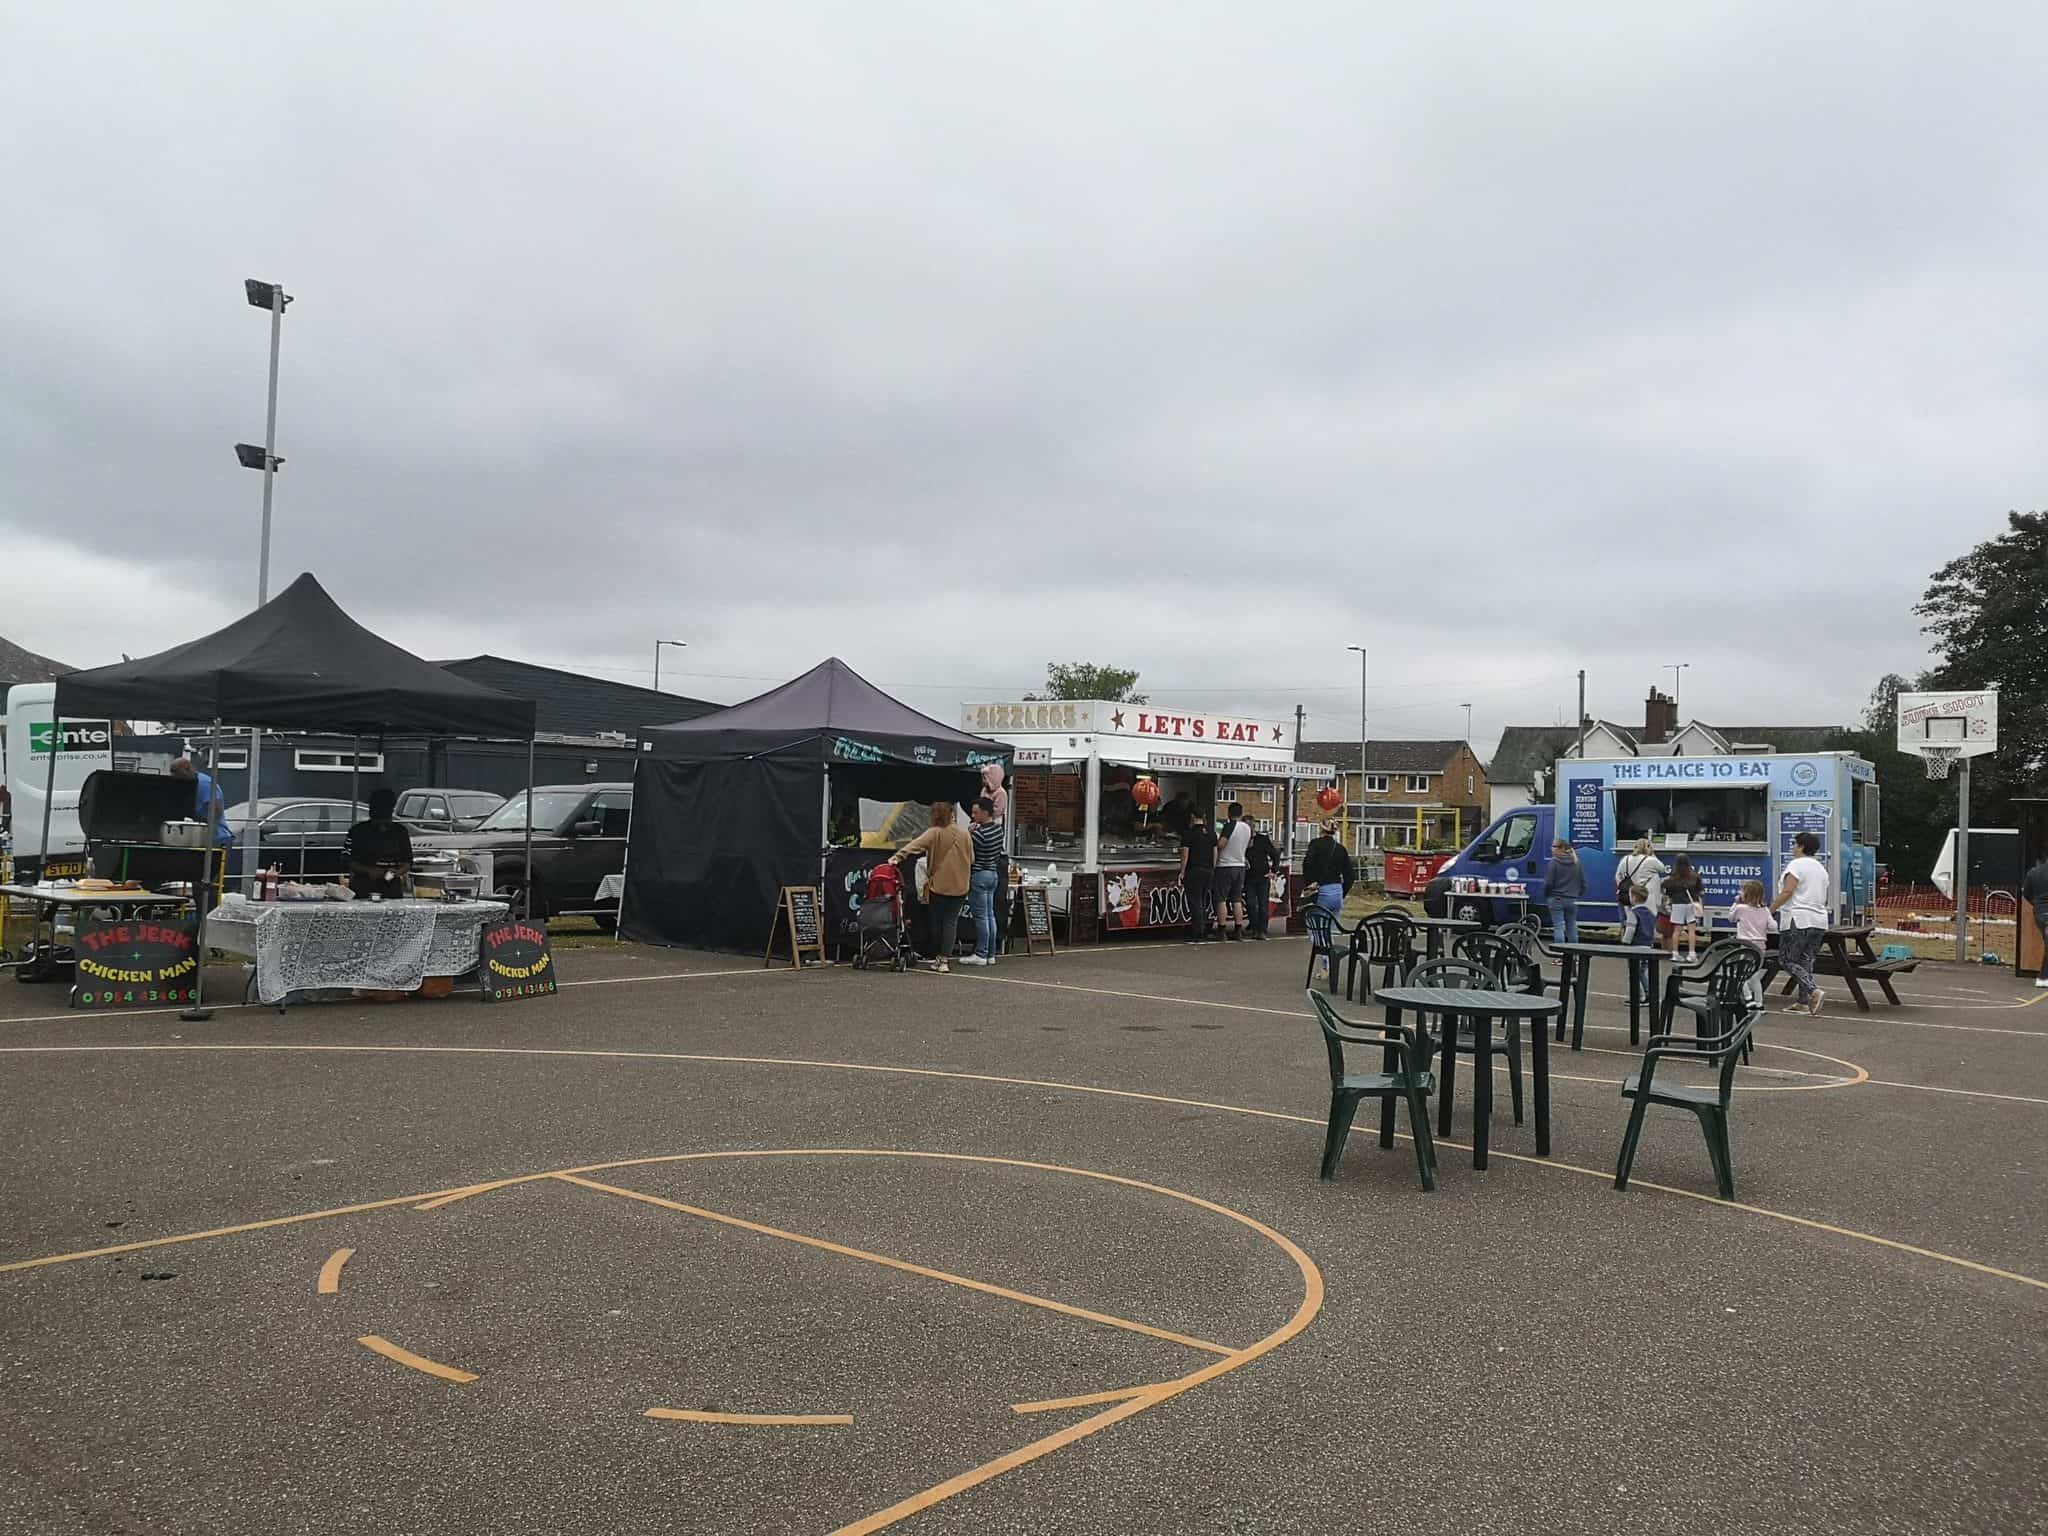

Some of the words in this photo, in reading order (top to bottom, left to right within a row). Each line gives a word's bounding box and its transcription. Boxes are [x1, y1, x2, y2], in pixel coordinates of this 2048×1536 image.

[1942, 695, 1985, 714] SHOT
[1137, 713, 1205, 738] LET'S
[1216, 721, 1259, 742] EAT
[1018, 751, 1040, 761] EAT
[1160, 757, 1183, 767] LET'S
[1185, 758, 1200, 768] EAT
[1208, 760, 1228, 769] LET'S
[1230, 761, 1244, 770] EAT
[1253, 763, 1272, 772] LET'S
[1273, 764, 1287, 773] EAT
[1296, 766, 1314, 775] LET'S
[1315, 767, 1328, 776] EAT
[1613, 764, 1642, 778] THE
[1647, 763, 1704, 778] PLAICE
[1710, 763, 1733, 777] TO
[1739, 762, 1771, 777] EAT
[1698, 866, 1717, 875] ALL
[1720, 866, 1762, 876] EVENTS
[82, 926, 131, 951] THE
[136, 924, 192, 951] JERK
[486, 927, 514, 950] THE
[514, 923, 544, 946] JERK
[80, 958, 153, 983] CHICKEN
[160, 956, 197, 980] MAN
[489, 959, 530, 979] CHICKEN
[531, 952, 551, 976] MAN
